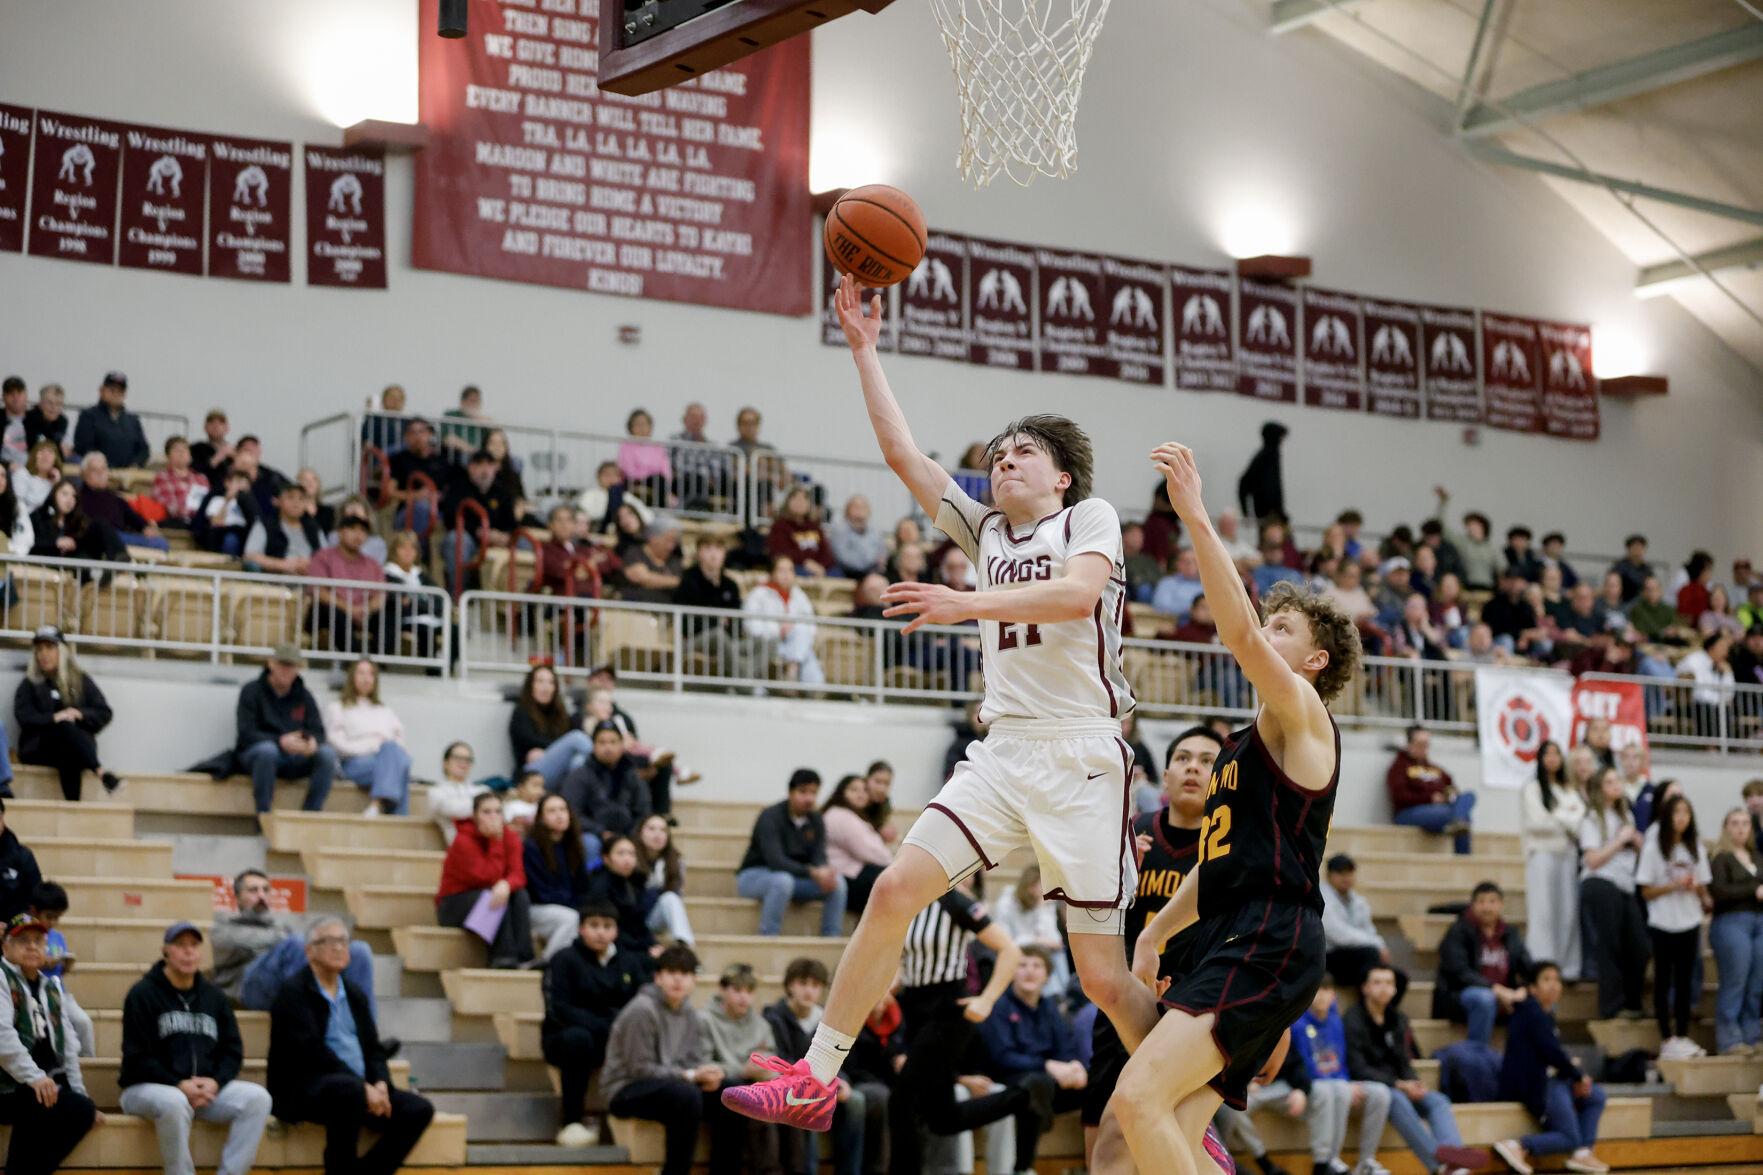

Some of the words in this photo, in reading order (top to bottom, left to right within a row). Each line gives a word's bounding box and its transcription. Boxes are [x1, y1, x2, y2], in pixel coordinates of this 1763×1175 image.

[484, 33, 513, 59] WE
[515, 38, 556, 65] GIVE
[465, 84, 522, 114] EVERY
[524, 93, 593, 124] BANNER
[596, 104, 637, 132] WILL
[639, 111, 679, 138] TELL
[681, 117, 715, 143] HER
[40, 117, 120, 149] Wrestling
[127, 130, 206, 160] Wrestling
[212, 141, 290, 169] Wrestling
[306, 151, 383, 176] Wrestling
[476, 141, 547, 172] MAROON
[549, 152, 586, 178] AND
[589, 157, 645, 187] WHITE
[646, 166, 681, 192] ARE
[683, 170, 756, 203] FIGHTING
[54, 188, 97, 209] Region
[142, 200, 186, 221] Region
[509, 173, 532, 199] TO
[535, 177, 587, 206] BRING
[590, 184, 637, 214] HOME
[639, 192, 655, 216] A
[656, 194, 724, 225] VICTORY
[39, 214, 108, 238] Champions
[230, 205, 273, 224] Region
[325, 214, 368, 233] Region
[477, 196, 506, 223] WE
[508, 201, 571, 232] PLEDGE
[573, 210, 608, 237] OUR
[610, 215, 675, 246] HEARTS
[677, 223, 700, 249] TO
[127, 227, 198, 249] Champions
[216, 232, 285, 253] Champions
[313, 241, 382, 259] Champions
[501, 228, 539, 255] AND
[541, 233, 616, 266] FOREVER
[618, 243, 653, 271] OUR
[834, 232, 861, 263] THE
[858, 255, 894, 279] ROCK
[987, 555, 1051, 587] KINGS
[1577, 689, 1622, 720] GET
